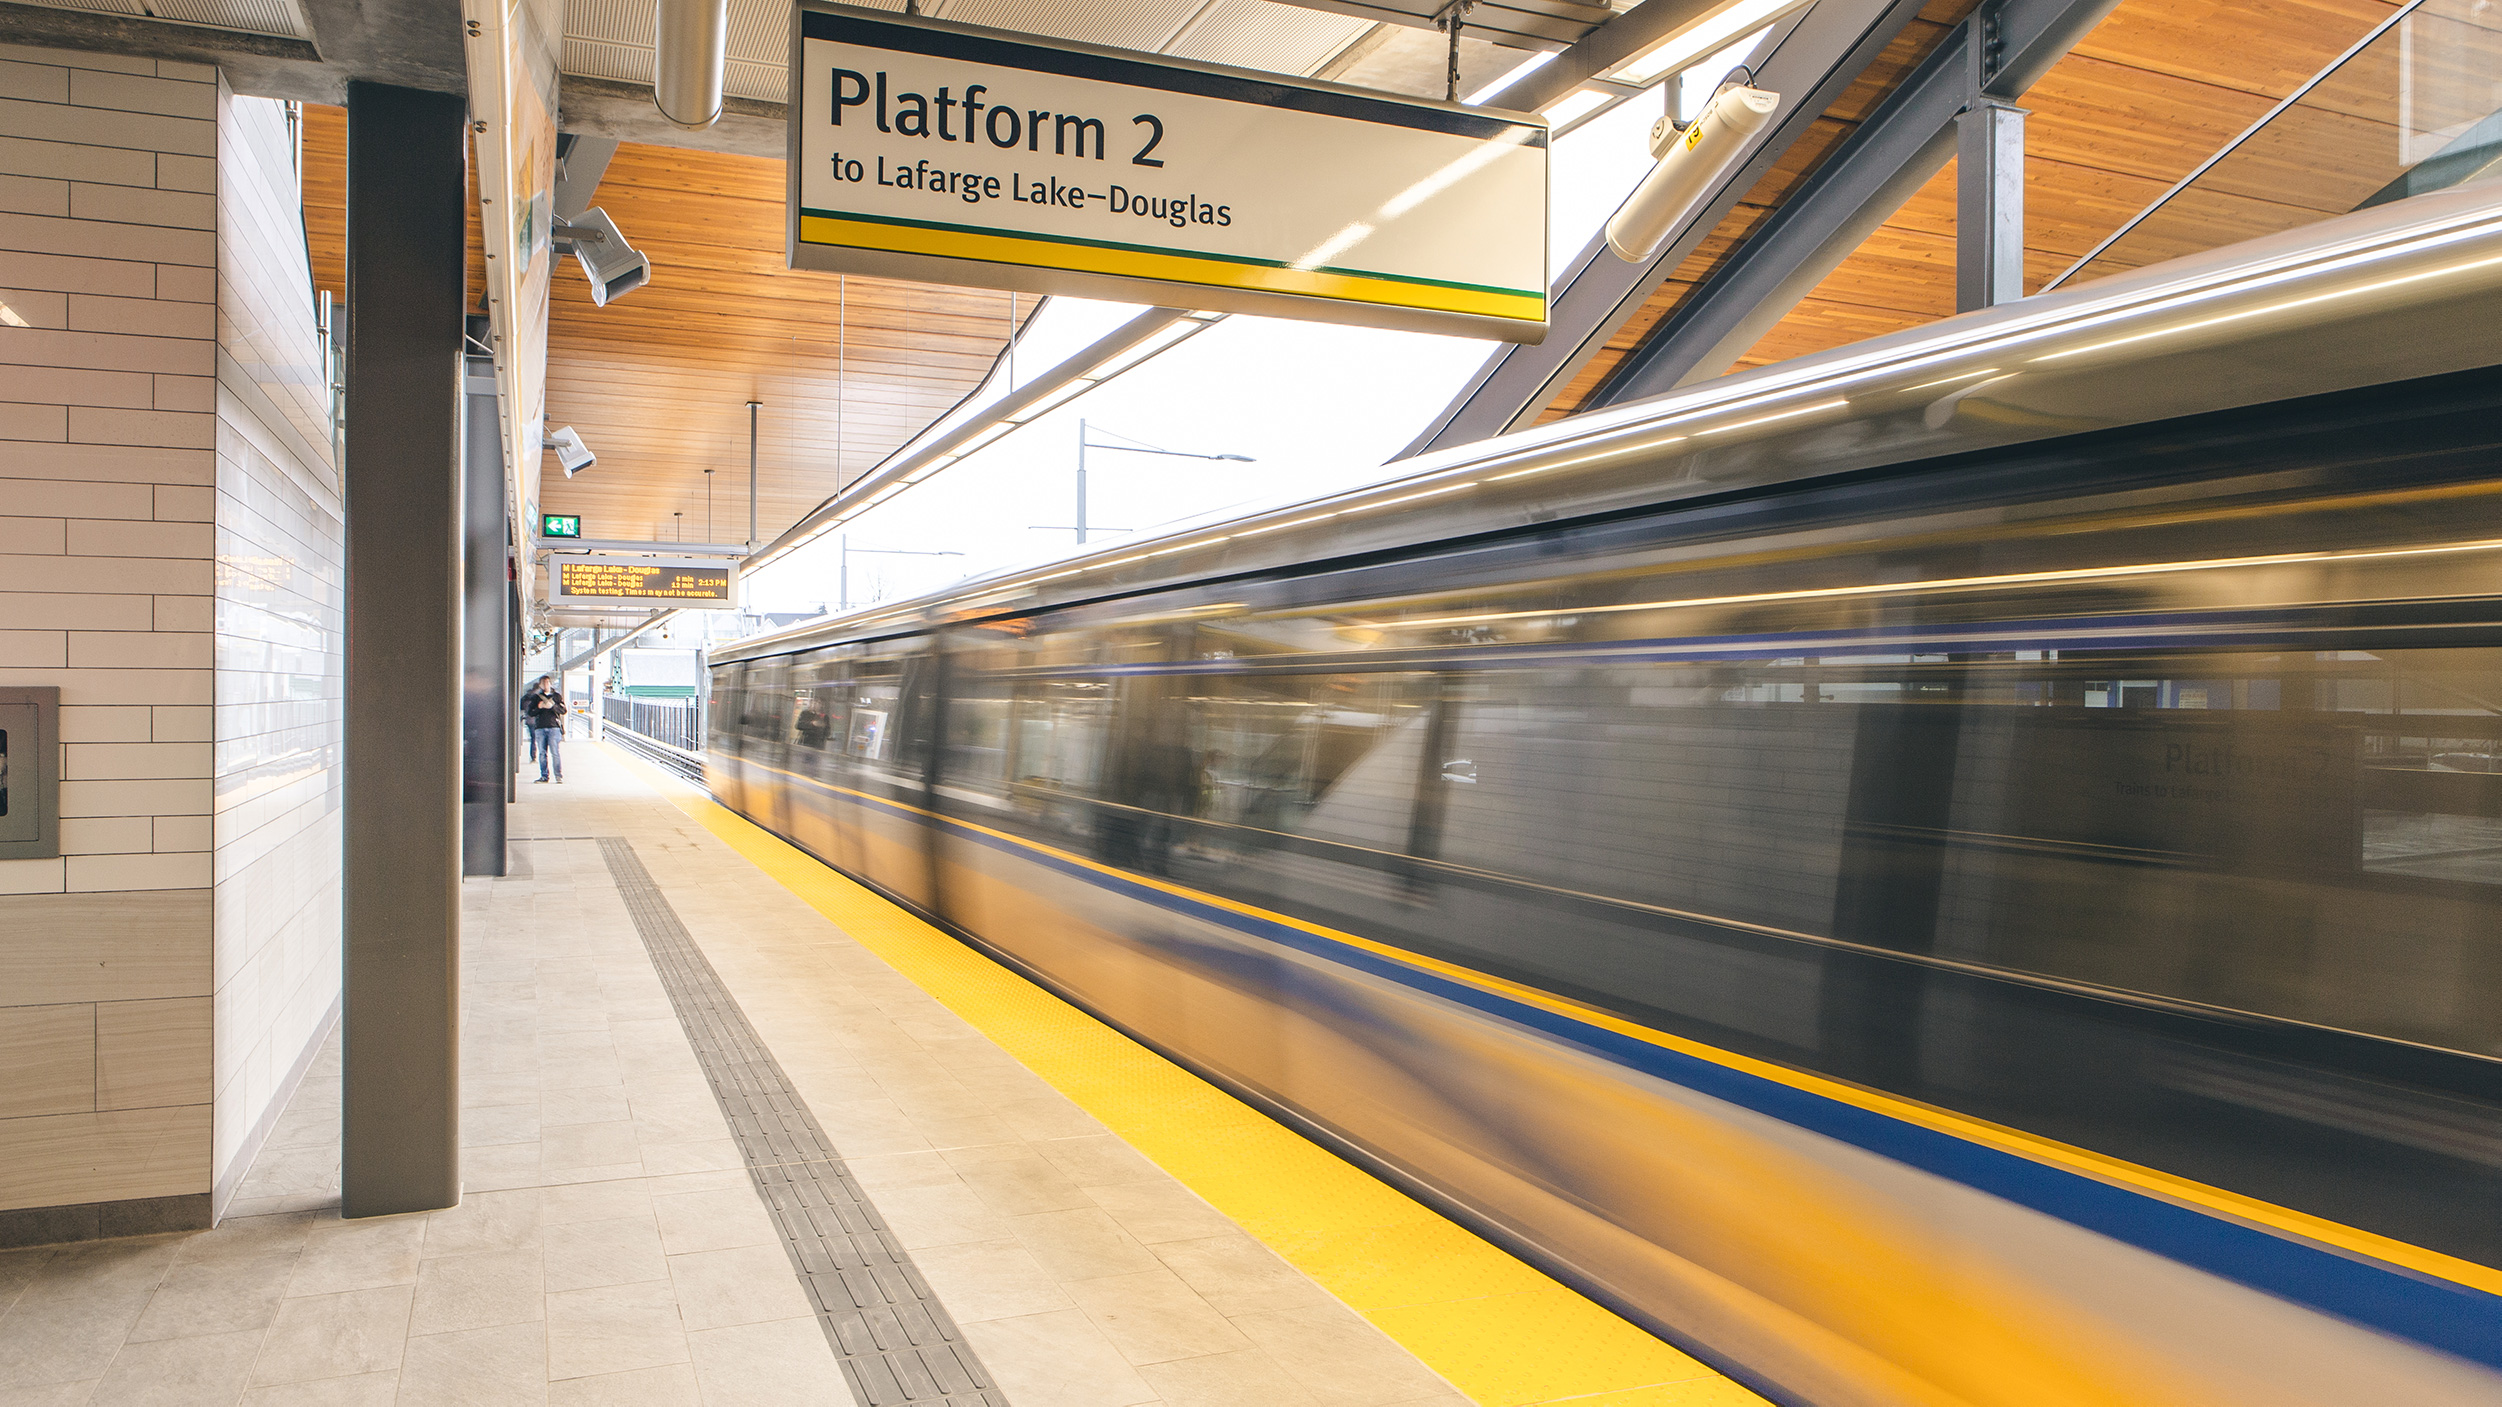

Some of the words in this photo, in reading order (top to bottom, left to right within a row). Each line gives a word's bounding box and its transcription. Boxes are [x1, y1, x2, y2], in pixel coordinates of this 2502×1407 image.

[831, 67, 1105, 161] Platform
[1132, 113, 1165, 169] 2
[831, 152, 864, 183] to
[878, 155, 1001, 204] Lafarge
[571, 564, 603, 574] Lafarge
[603, 565, 623, 573] Lake
[628, 565, 660, 575] Douglas
[571, 572, 596, 581] Lafarge
[617, 574, 643, 582] Douglas
[698, 578, 714, 587] 2:13
[715, 579, 727, 587] PM
[571, 579, 596, 587] Lafarge
[617, 580, 643, 588] Douglas
[571, 586, 597, 595] System
[625, 588, 646, 596] Times
[647, 589, 663, 597] may
[2114, 780, 2151, 797] Trains
[2154, 784, 2167, 797] to
